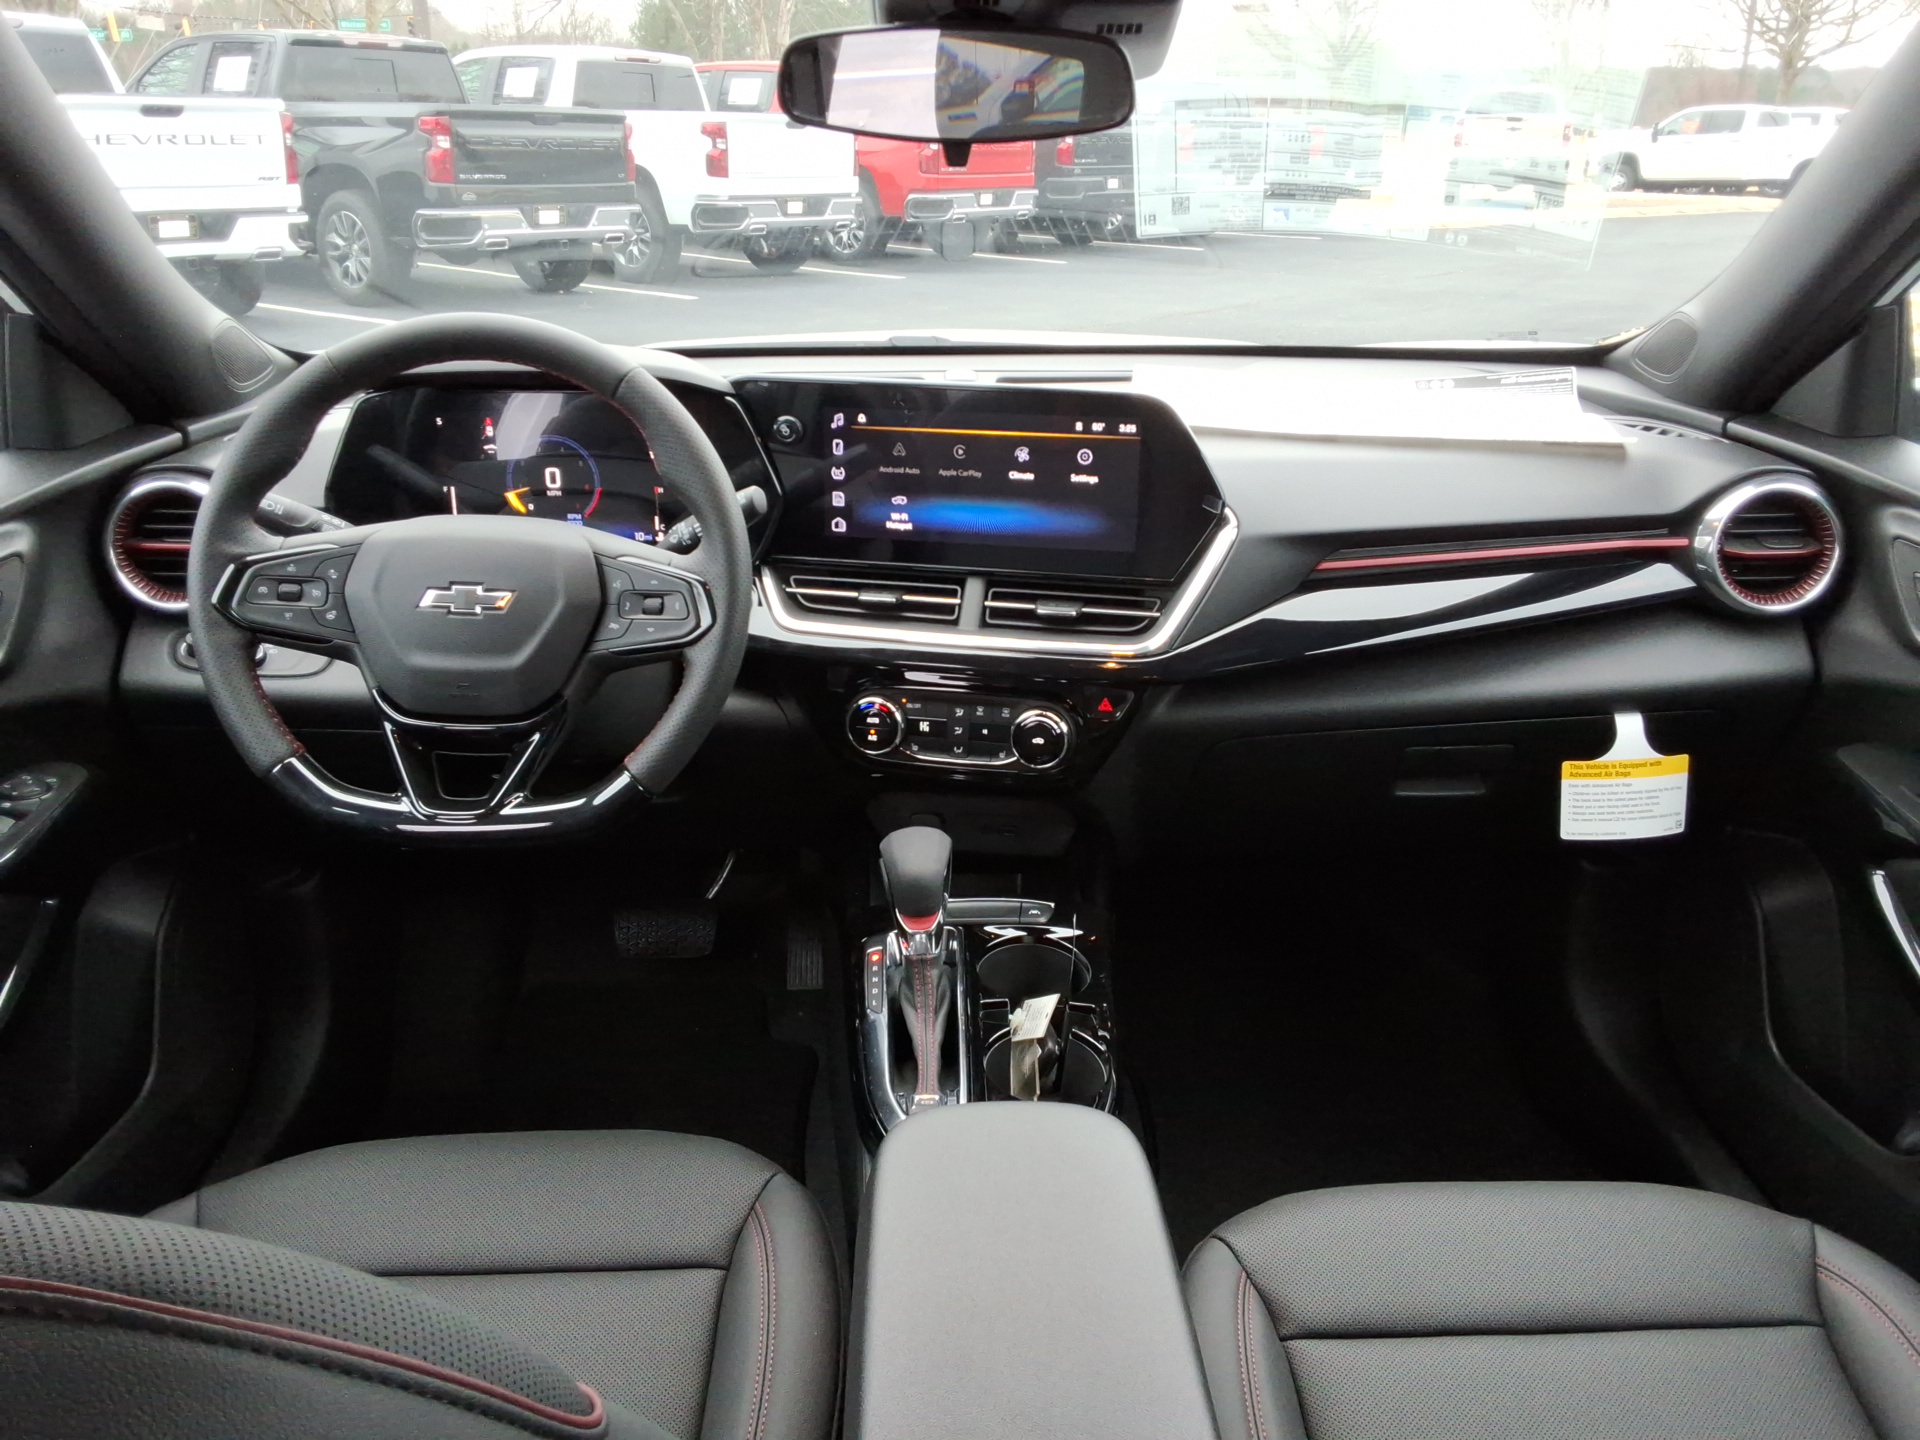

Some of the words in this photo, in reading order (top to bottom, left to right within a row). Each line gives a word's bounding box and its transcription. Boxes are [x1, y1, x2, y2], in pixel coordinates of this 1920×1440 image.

[85, 134, 267, 146] HEVROLET
[879, 466, 904, 475] Android
[905, 467, 920, 475] Auto
[938, 468, 957, 478] Apple
[958, 469, 982, 479] CarPlay
[1008, 470, 1035, 481] Climate
[544, 467, 562, 488] 0
[1070, 473, 1099, 484] Settings
[885, 521, 913, 531] Hotspot
[1585, 762, 1609, 770] Vehicle
[1619, 761, 1648, 770] Equipped
[1615, 770, 1631, 778] Bags
